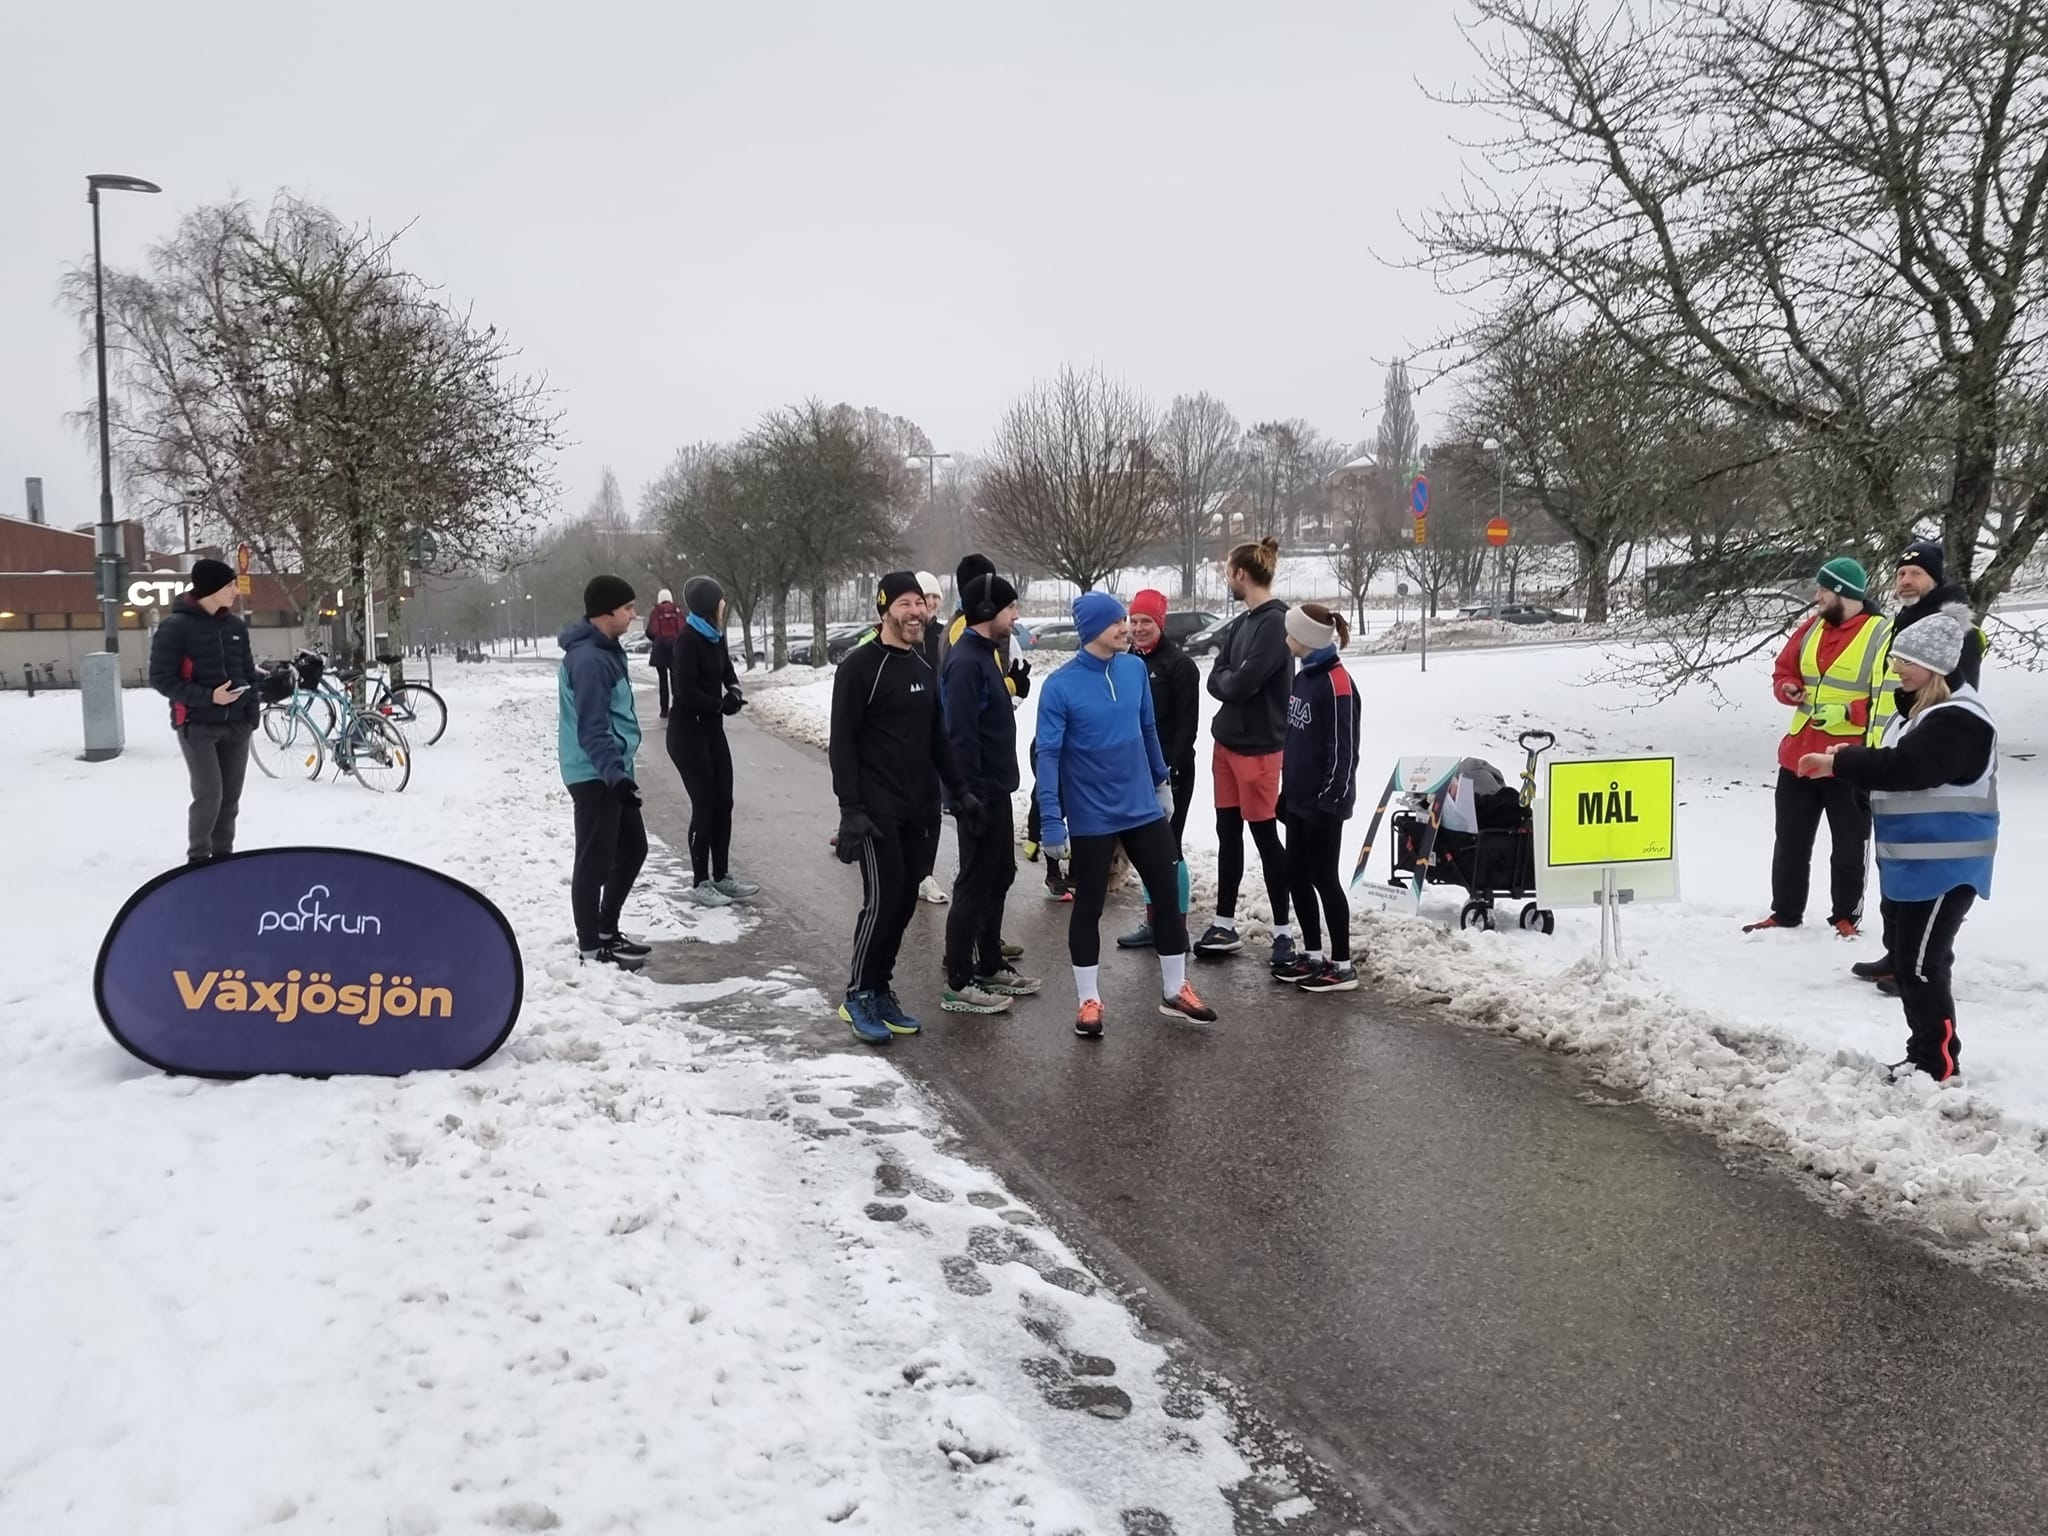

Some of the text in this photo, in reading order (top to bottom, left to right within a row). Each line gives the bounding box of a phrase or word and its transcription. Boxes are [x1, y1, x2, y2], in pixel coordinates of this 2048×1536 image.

[1577, 781, 1639, 825] MÅL
[257, 884, 381, 936] parkrun
[172, 969, 454, 1026] Växjösjön
